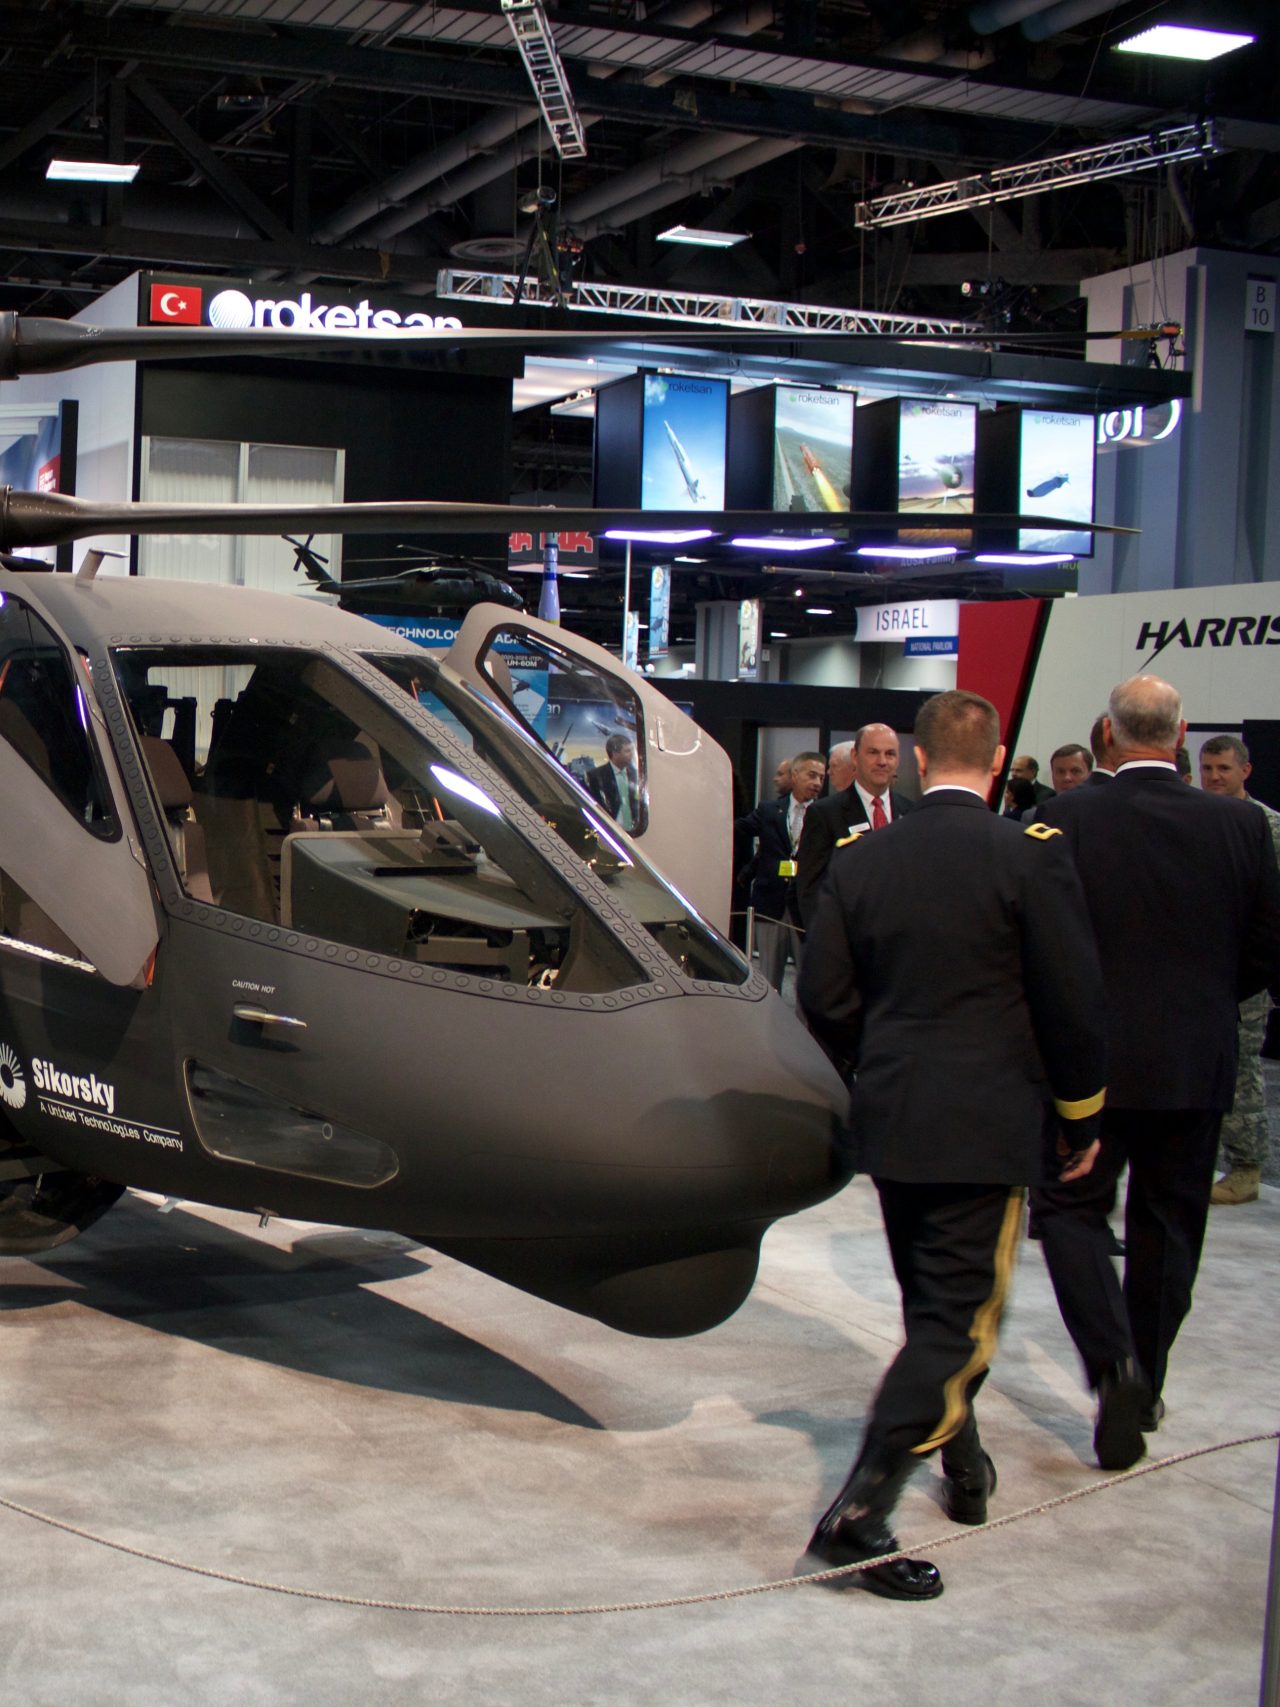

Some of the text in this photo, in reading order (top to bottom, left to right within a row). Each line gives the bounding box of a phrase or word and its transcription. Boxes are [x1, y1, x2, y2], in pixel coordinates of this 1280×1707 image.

[1256, 286, 1266, 303] B
[1252, 308, 1269, 325] 10
[669, 383, 713, 395] roketsan
[798, 393, 840, 406] roketsan
[922, 406, 962, 417] roketsan
[1041, 415, 1081, 427] roketsan
[876, 607, 929, 632] ISRAEL
[386, 627, 460, 640] CHNOLO
[1136, 615, 1280, 672] HARRIS
[231, 979, 276, 995] CAUTION HOT
[31, 1057, 115, 1115] Sikorsky
[40, 1101, 184, 1153] A United Technologies Company
